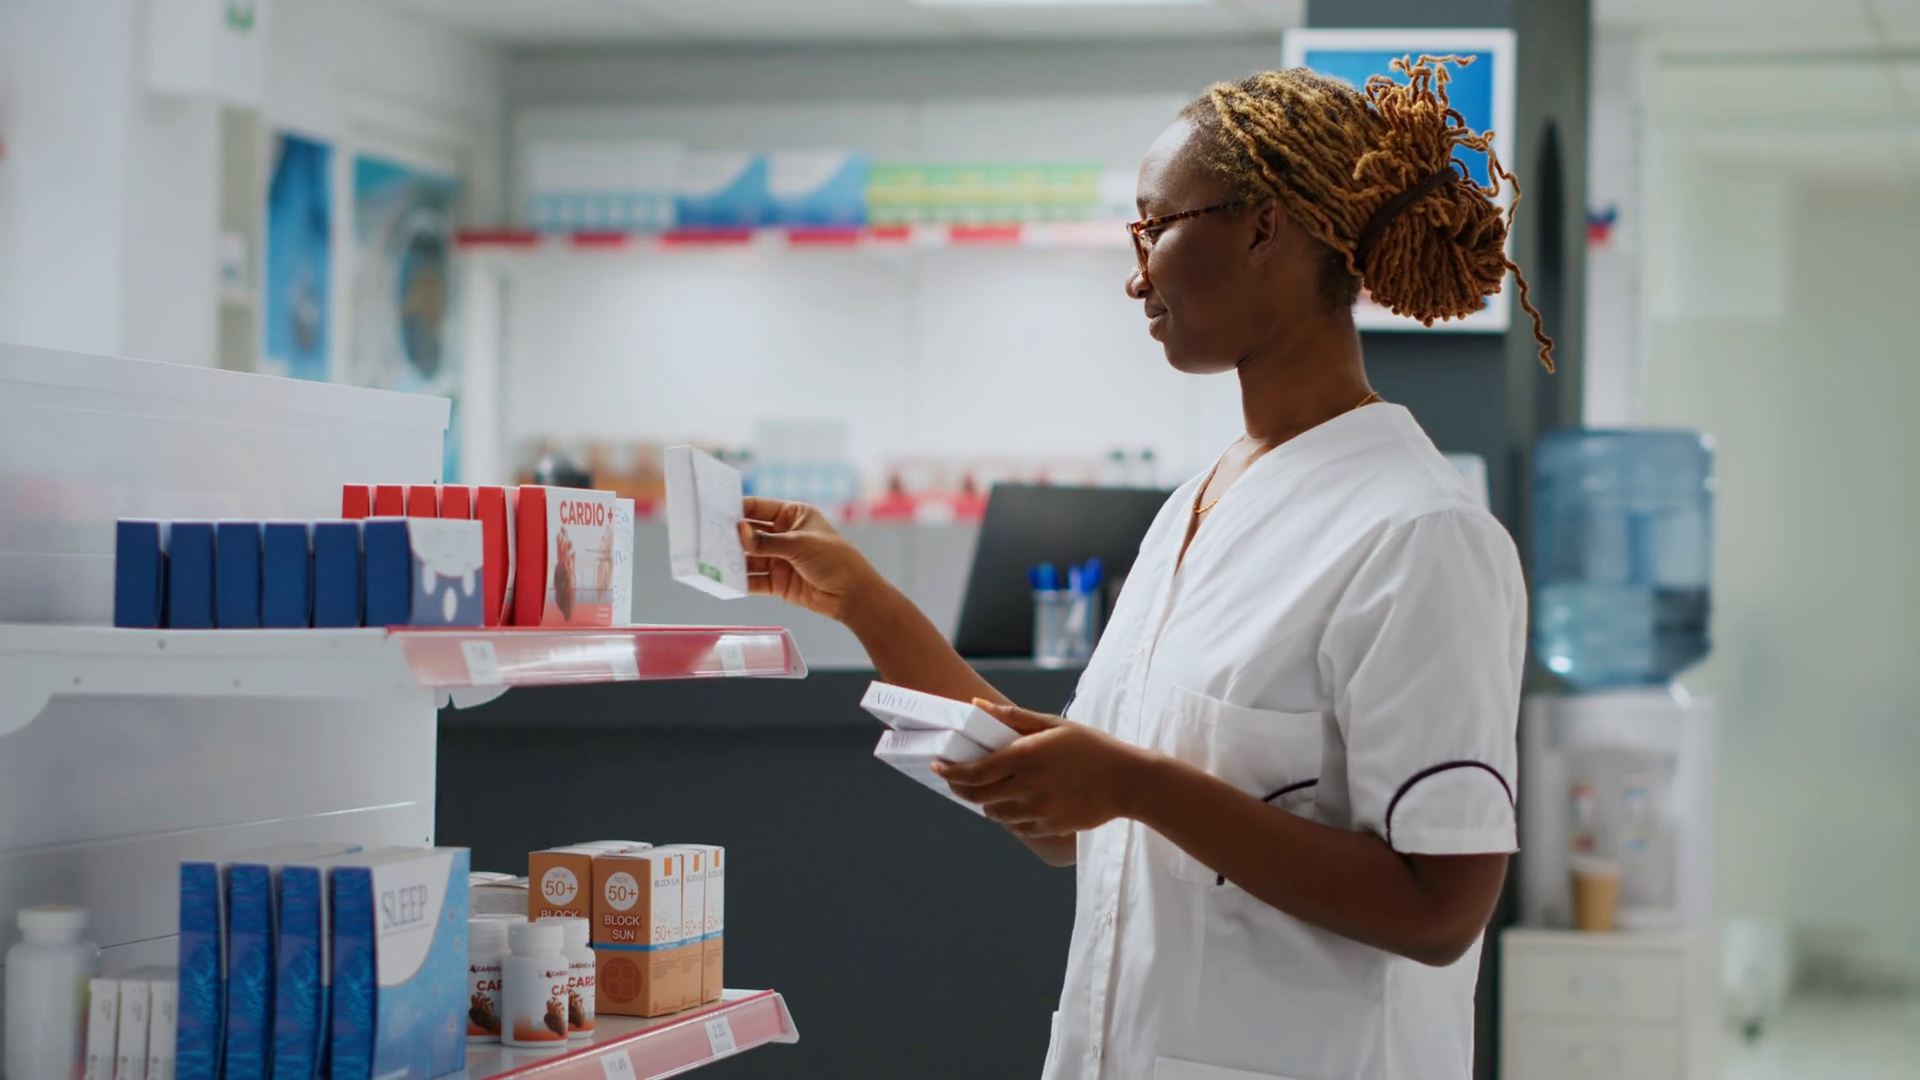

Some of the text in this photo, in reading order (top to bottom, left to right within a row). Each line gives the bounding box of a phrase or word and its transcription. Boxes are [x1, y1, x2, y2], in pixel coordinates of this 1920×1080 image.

[560, 500, 605, 527] CARDIO
[544, 880, 576, 896] 50+
[654, 879, 671, 888] BLOCK
[608, 885, 637, 902] 50+
[381, 884, 428, 929] SLEEP
[604, 914, 640, 927] BLOCK
[612, 929, 635, 940] SUN
[655, 925, 671, 941] 50+
